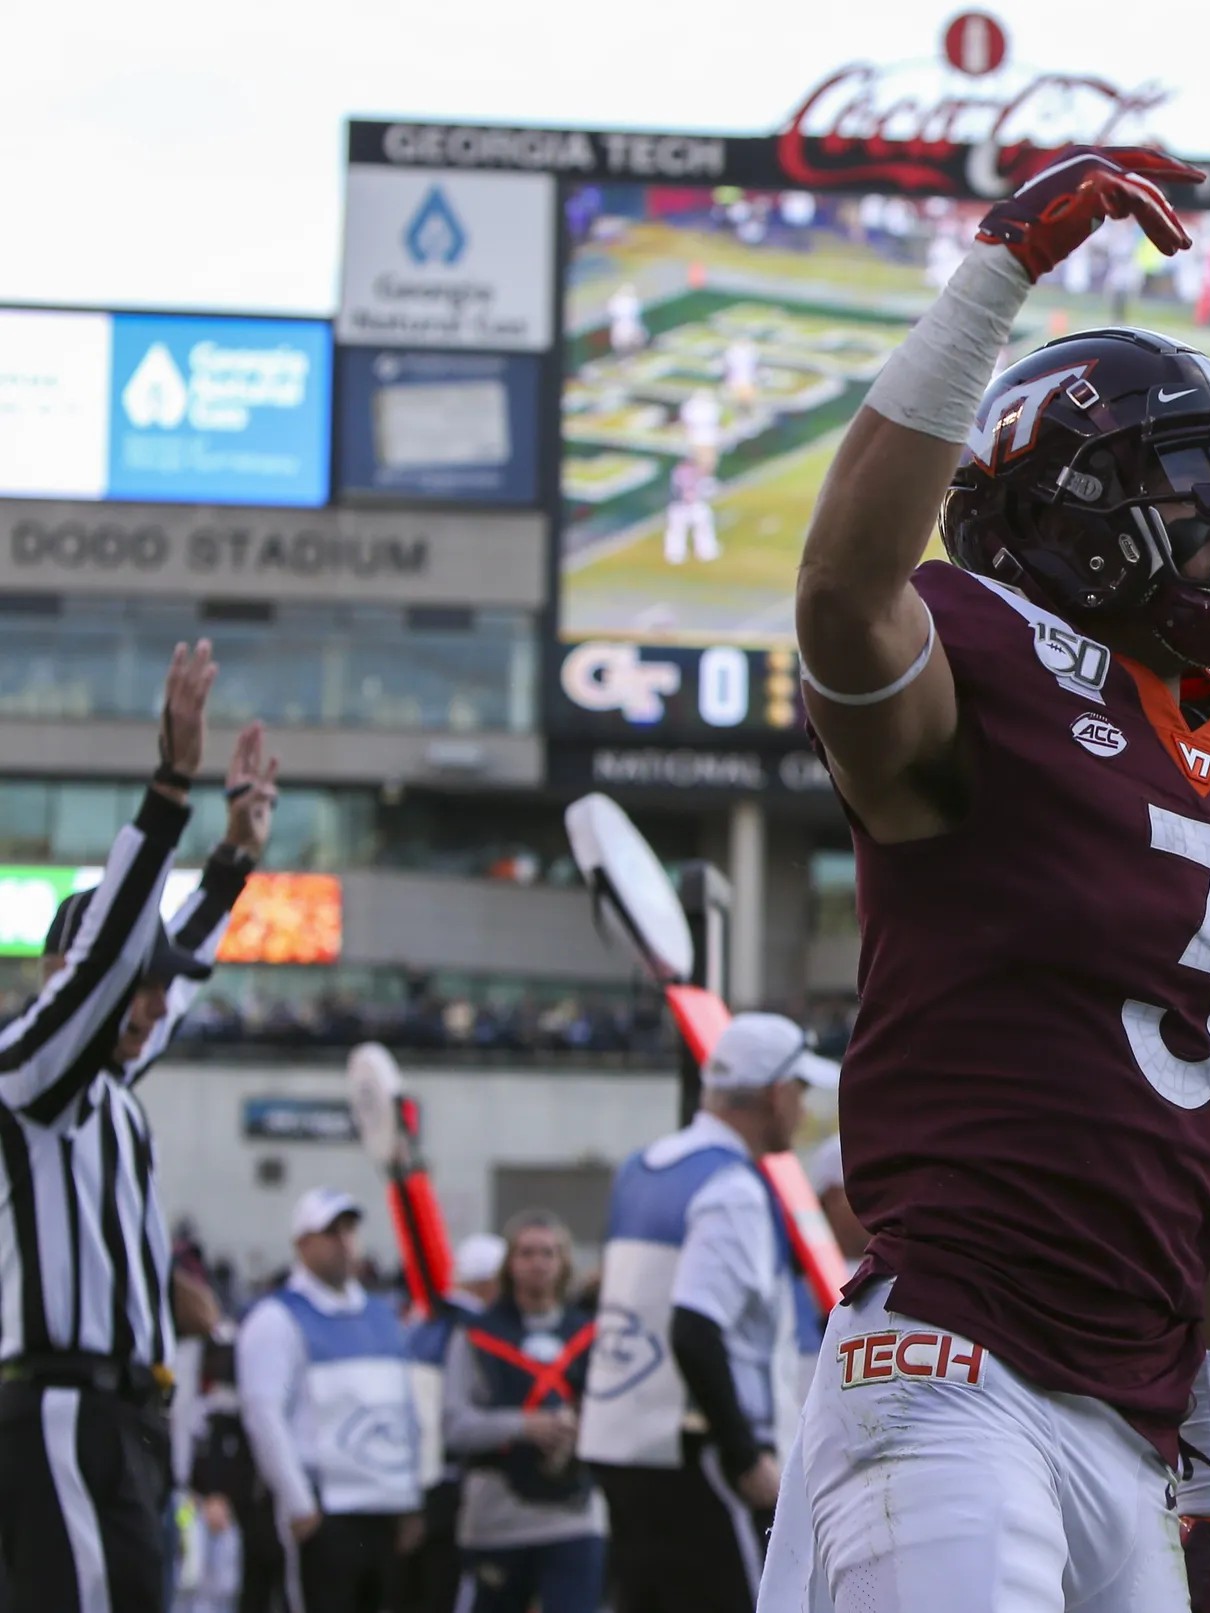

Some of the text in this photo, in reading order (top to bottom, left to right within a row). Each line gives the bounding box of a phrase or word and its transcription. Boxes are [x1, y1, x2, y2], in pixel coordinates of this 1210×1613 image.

[382, 124, 724, 174] GEORGIA TECH
[11, 520, 431, 575] DODD STADIUM
[1034, 620, 1111, 690] 150
[699, 645, 749, 727] 0
[1079, 722, 1121, 748] ACC
[839, 1333, 984, 1385] TECH
